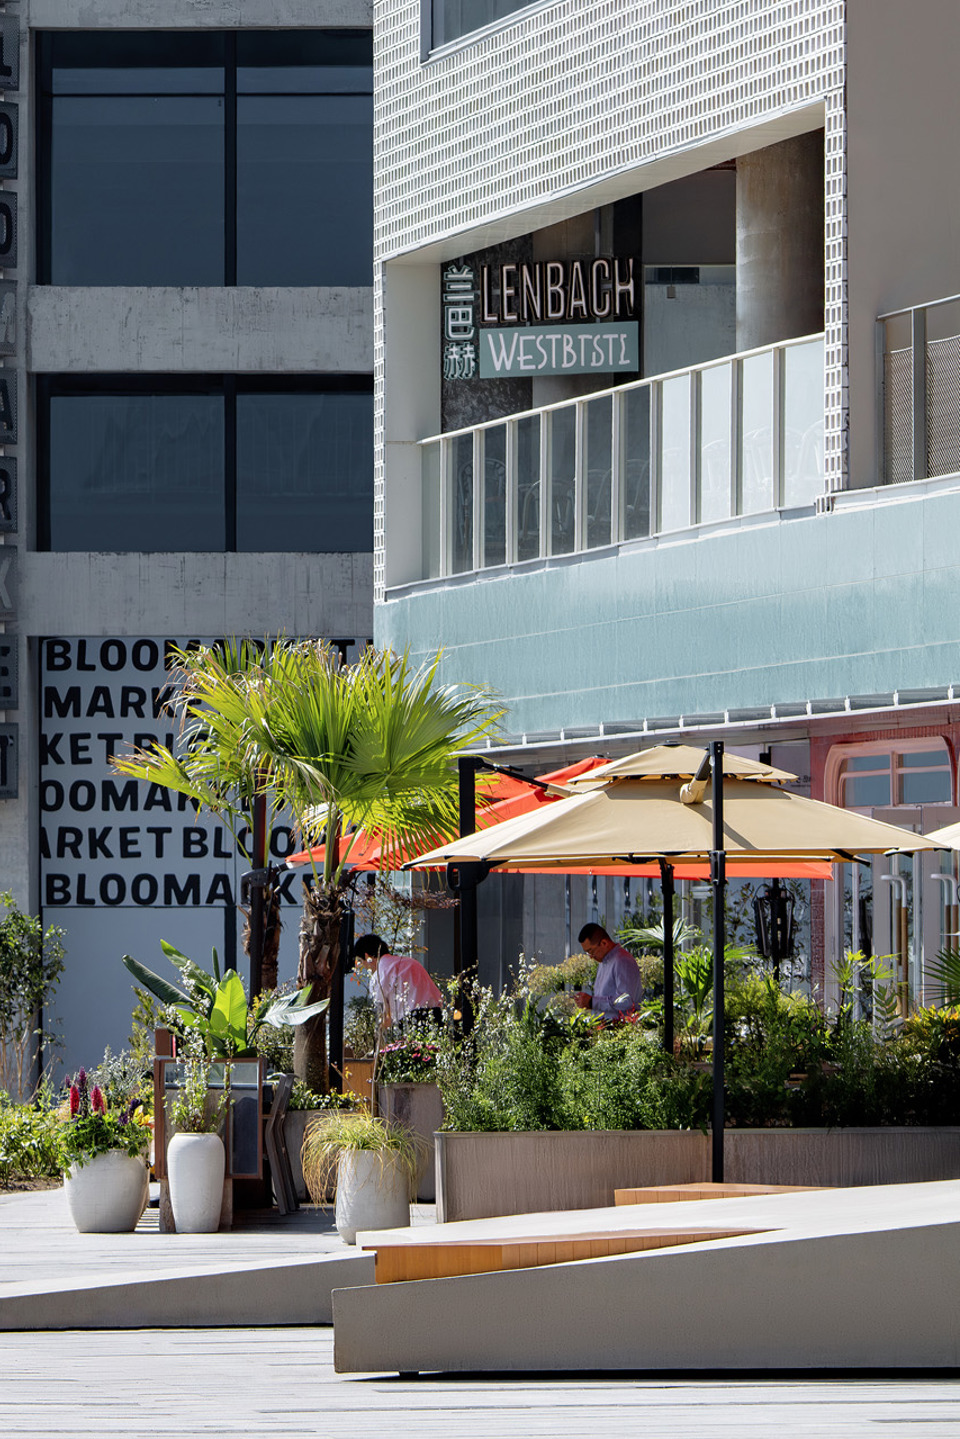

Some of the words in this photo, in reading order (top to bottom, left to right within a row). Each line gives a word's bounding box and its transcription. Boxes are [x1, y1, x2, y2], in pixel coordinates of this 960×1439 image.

[443, 264, 475, 380] 兰巴赫
[482, 259, 635, 322] LENBACH
